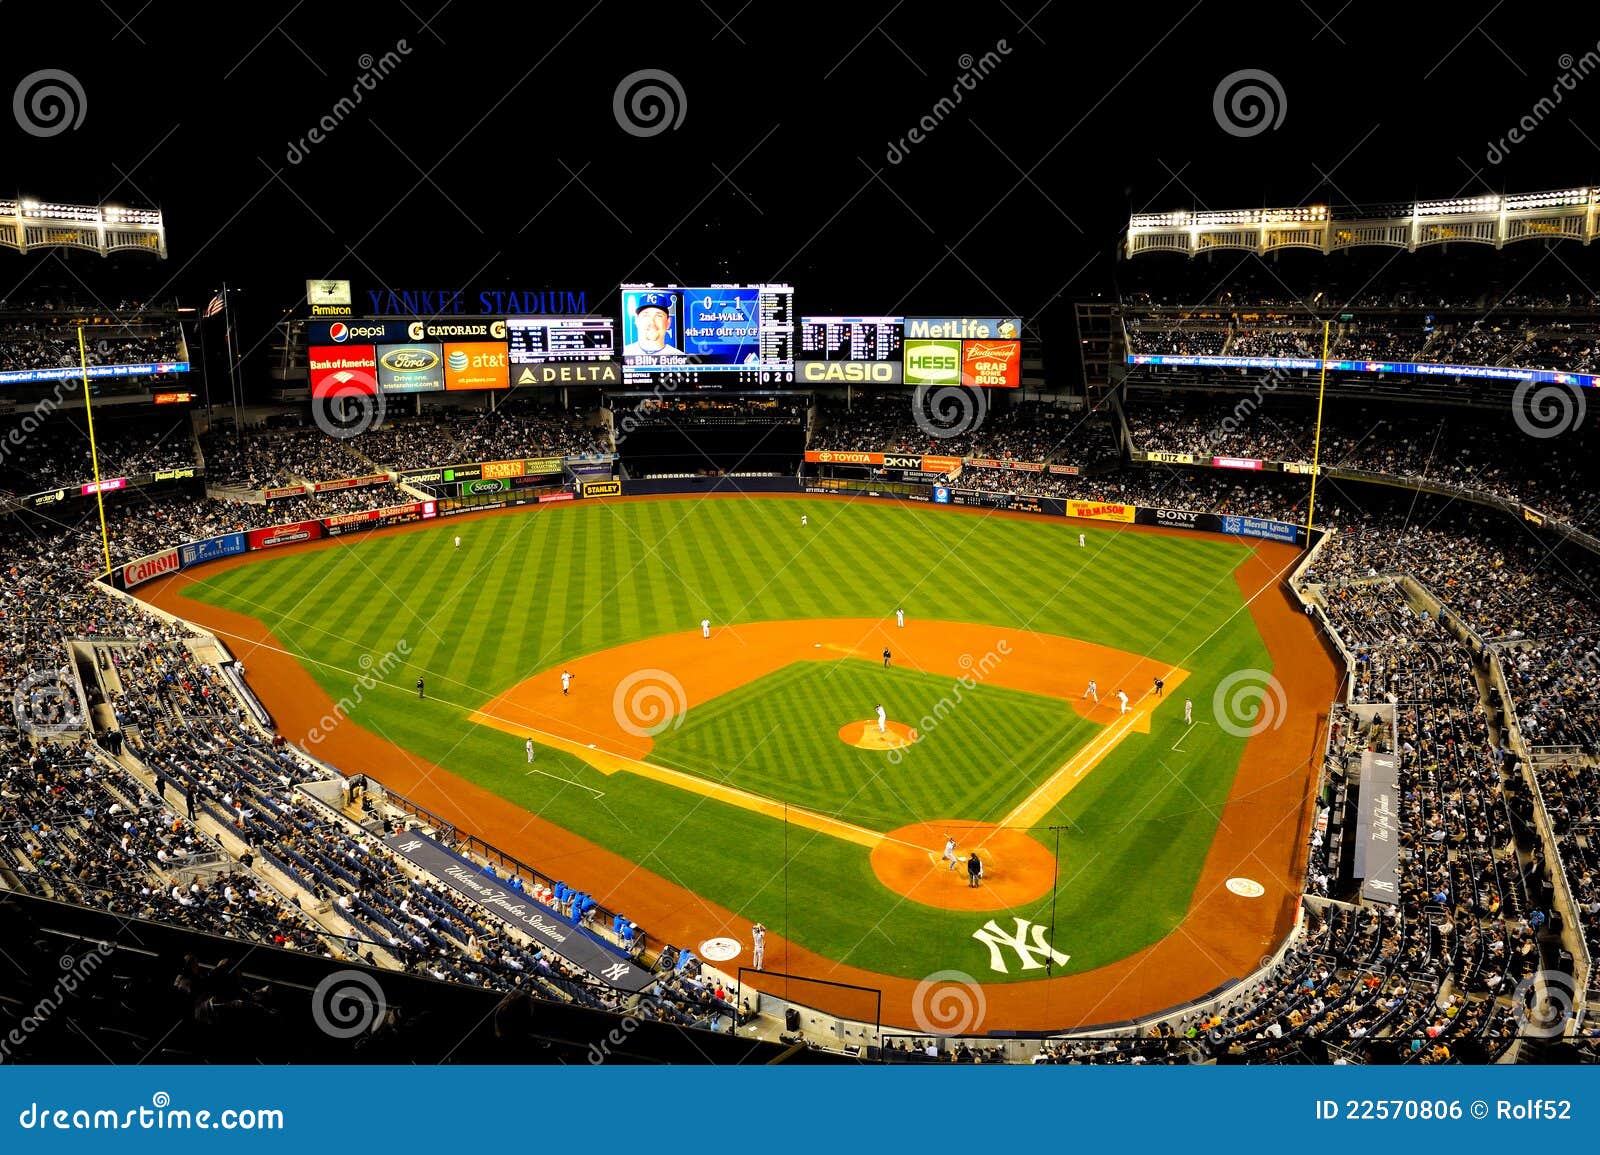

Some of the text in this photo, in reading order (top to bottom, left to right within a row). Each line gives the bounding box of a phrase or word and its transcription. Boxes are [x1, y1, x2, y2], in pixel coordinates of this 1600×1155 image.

[369, 290, 586, 314] YANKEE STADIUM
[312, 305, 351, 315] Armitron
[699, 312, 744, 321] 2nd-WALK
[349, 324, 385, 338] pepsi
[428, 325, 486, 336] GATORADE
[716, 328, 734, 336] OUT
[735, 328, 746, 336] TO
[910, 318, 989, 339] MetLife
[966, 347, 1016, 358] Budweiser
[310, 358, 375, 370] Bank of America
[394, 353, 426, 368] Ford
[472, 352, 506, 368] at&t
[635, 355, 658, 366] Billy
[660, 355, 688, 365] Butler
[910, 356, 956, 369] HESS
[805, 362, 892, 381] CASIO
[975, 362, 1007, 371] GRAB
[543, 366, 616, 382] DELTA
[763, 372, 770, 382] 0
[774, 372, 781, 382] 2
[786, 372, 793, 382] 0
[975, 376, 1007, 385] BUDS
[833, 453, 871, 462] TOYOTA
[884, 457, 921, 468] DKNY
[1160, 454, 1178, 462] UTZ
[484, 461, 522, 473] SPORTS
[474, 482, 499, 492] Scotts
[587, 484, 618, 494] STANLEY
[1156, 509, 1199, 521] SONY
[1244, 518, 1267, 530] Merrill
[1269, 522, 1289, 534] Lynch
[1244, 527, 1261, 536] Wealth
[199, 545, 241, 559] CONSULTING
[124, 552, 178, 584] Canon
[444, 865, 567, 943] Welcome to Yankee Stadium
[972, 917, 1071, 974] NY
[601, 963, 630, 981] NY
